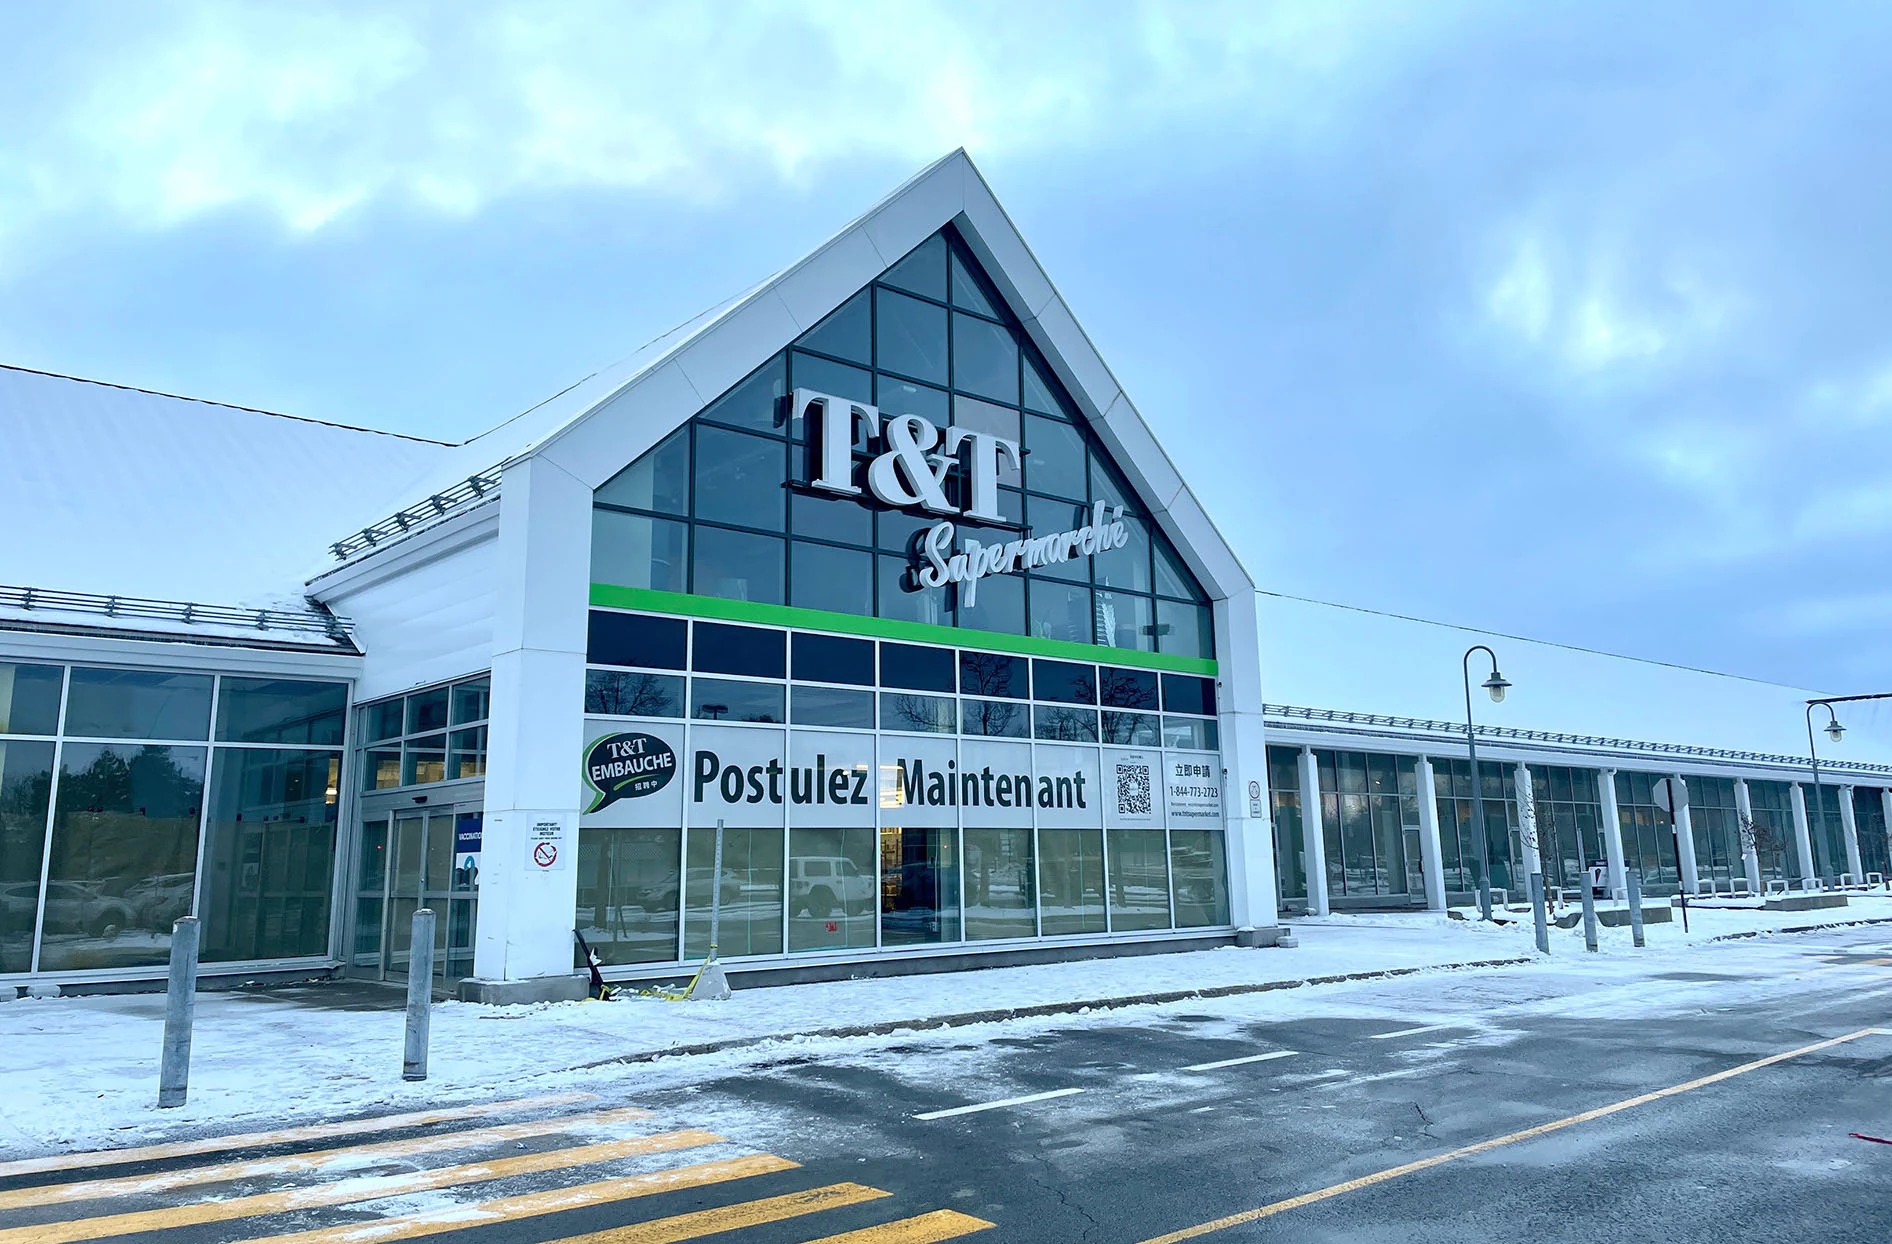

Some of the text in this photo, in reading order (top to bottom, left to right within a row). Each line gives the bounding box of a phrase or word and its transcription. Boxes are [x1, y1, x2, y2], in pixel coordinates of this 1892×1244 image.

[792, 387, 1020, 522] T&T
[919, 500, 1129, 608] Supermarché
[606, 738, 648, 759] T&T
[592, 752, 673, 781] EMBAUCHE
[693, 750, 1087, 809] Postulez Maintenant
[1175, 763, 1211, 778] 立即申請
[1169, 786, 1219, 798] 1-844-773-2723
